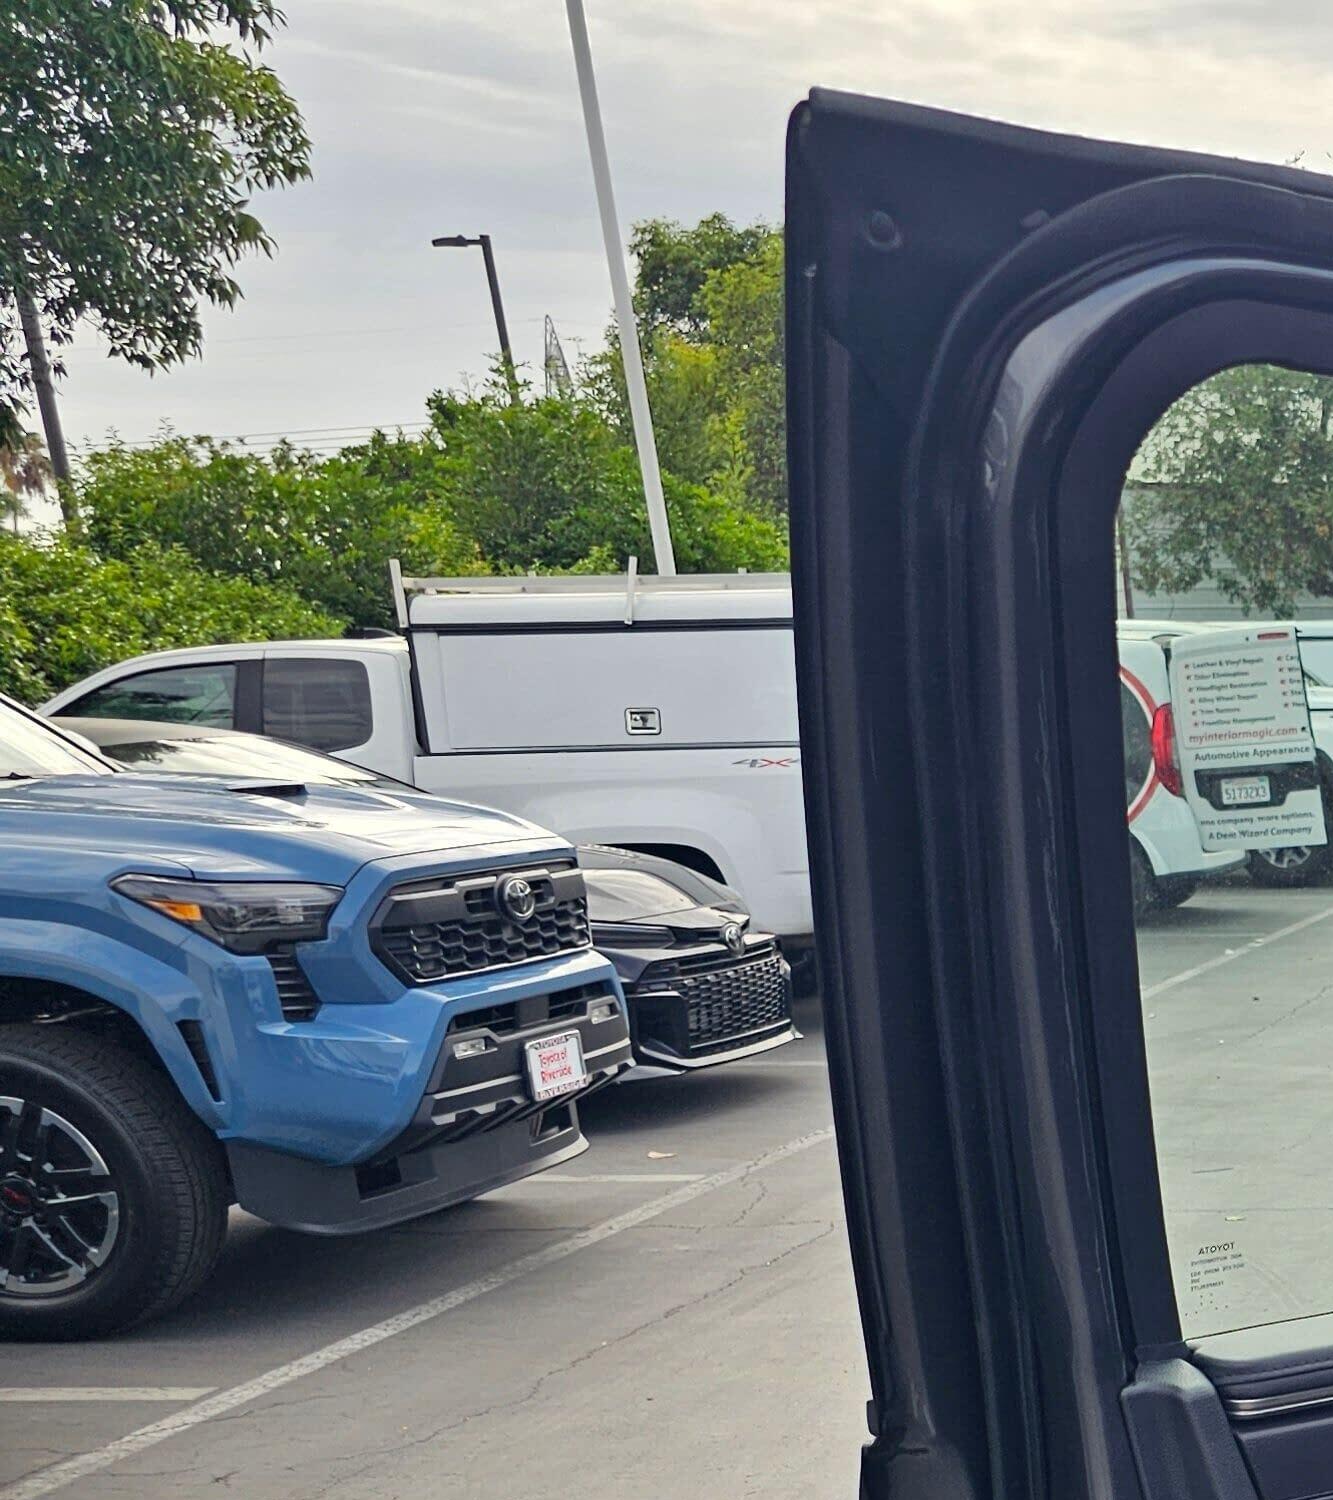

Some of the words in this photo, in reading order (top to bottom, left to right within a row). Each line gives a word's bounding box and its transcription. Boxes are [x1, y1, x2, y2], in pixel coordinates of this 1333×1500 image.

[1189, 727, 1297, 744] myinteriormagic.com
[1194, 751, 1250, 761] Automotive
[1253, 745, 1310, 758] Appearance
[1239, 829, 1268, 838] Wizard
[1270, 826, 1313, 836] Company
